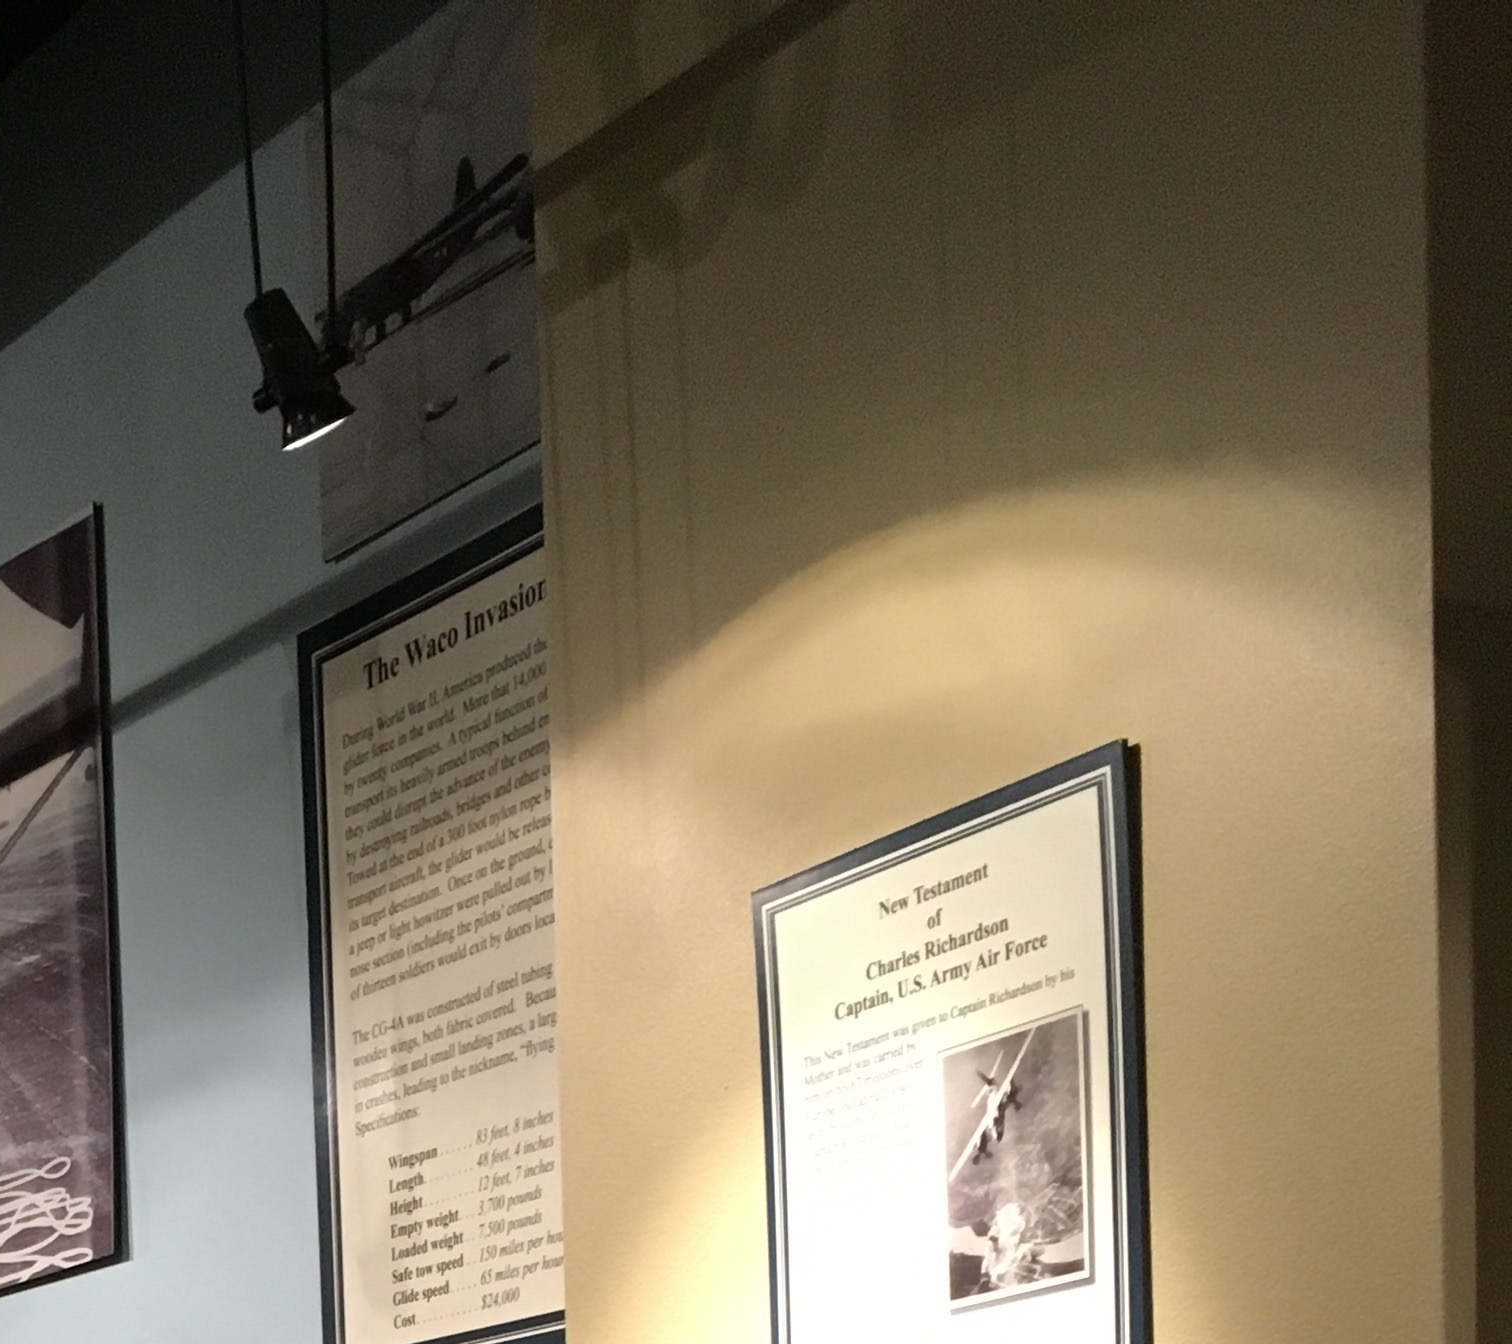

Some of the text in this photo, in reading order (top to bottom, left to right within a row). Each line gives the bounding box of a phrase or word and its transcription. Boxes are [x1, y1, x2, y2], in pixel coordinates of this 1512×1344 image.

[362, 656, 400, 690] The
[404, 627, 459, 667] Waco
[878, 863, 988, 919] New Testament
[926, 907, 942, 929] of
[865, 917, 1009, 980] Charles Richardson
[834, 934, 1047, 1020] Captain, U.S. Army Air Force
[387, 1147, 437, 1170] Wingspan
[388, 1171, 424, 1194] Length
[389, 1195, 423, 1216] Height
[390, 1220, 423, 1239] Empty
[425, 1208, 458, 1229] weight
[390, 1238, 428, 1261] Loaded
[429, 1230, 463, 1251] weight
[391, 1266, 413, 1284] Safe
[415, 1263, 433, 1278] tow
[435, 1252, 464, 1276] speed
[392, 1287, 419, 1306] Glide
[421, 1279, 450, 1303] speed
[392, 1312, 416, 1329] Cost
